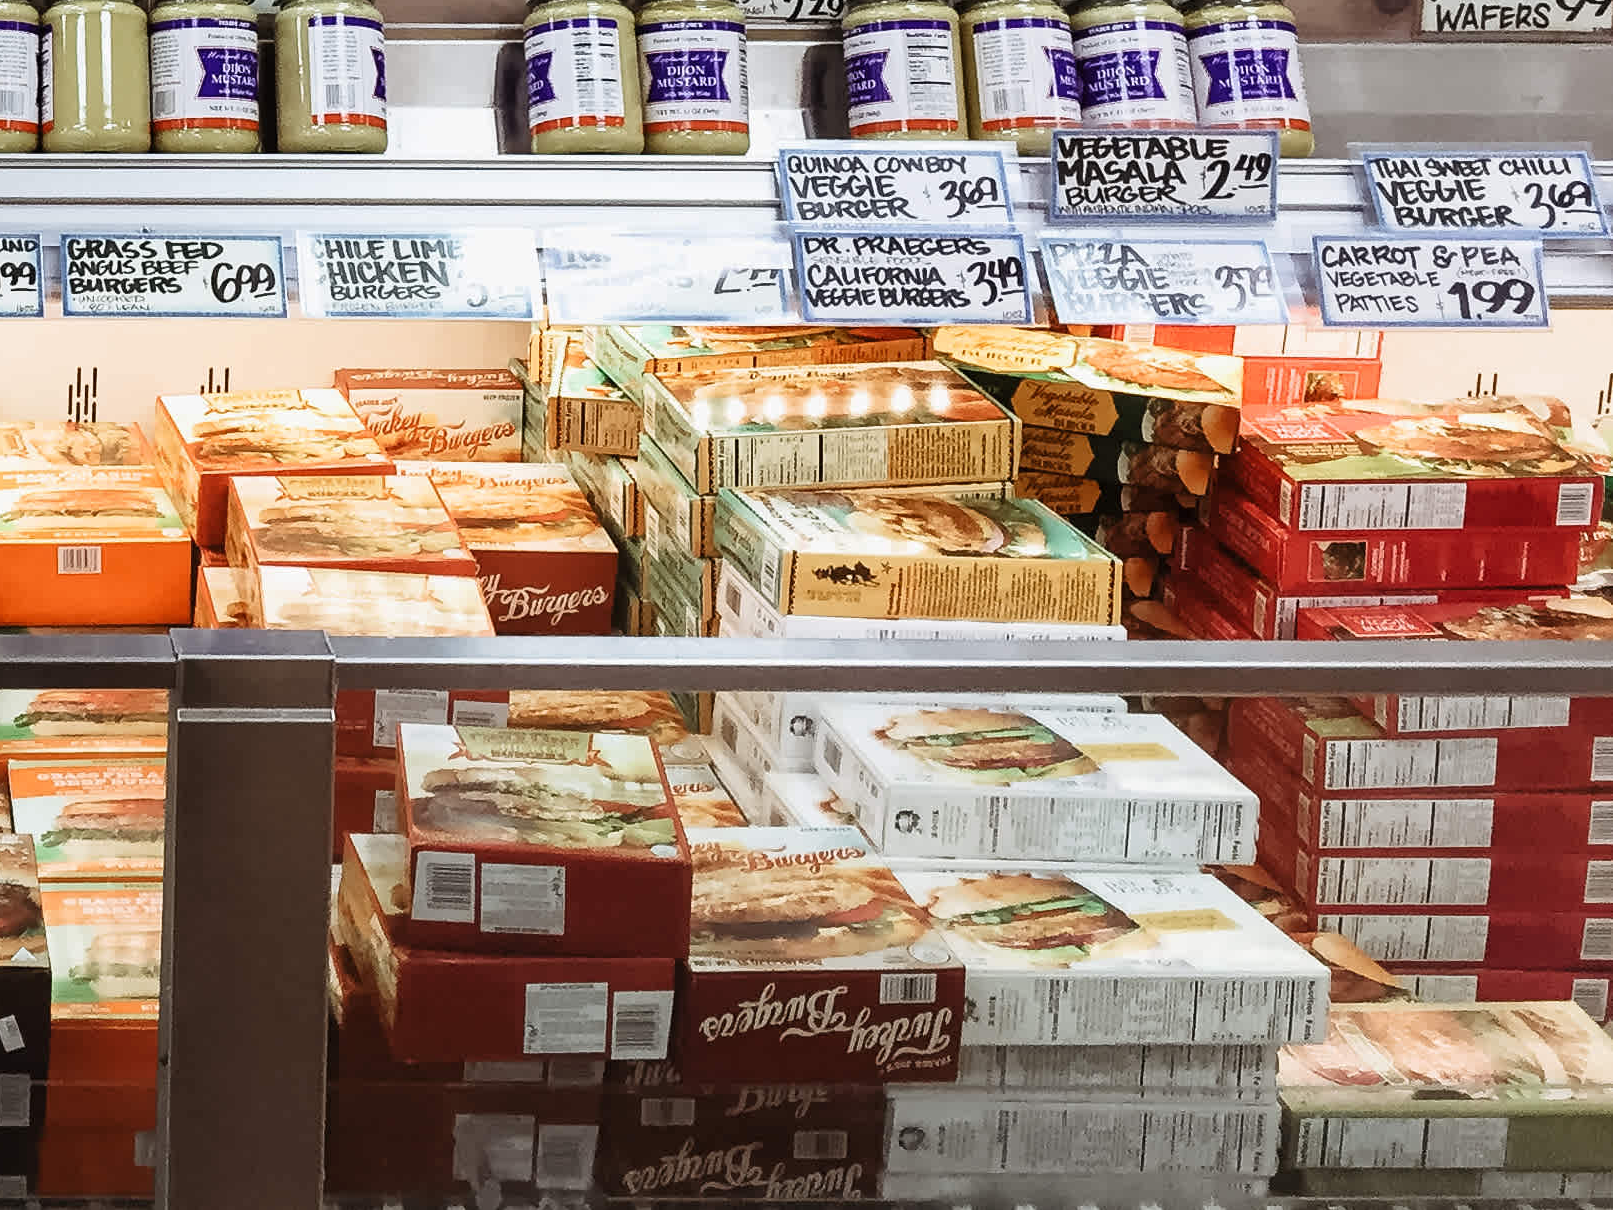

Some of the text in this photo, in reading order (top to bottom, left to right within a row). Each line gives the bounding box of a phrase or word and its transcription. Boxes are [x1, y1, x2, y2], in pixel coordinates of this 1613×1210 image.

[1436, 4, 1551, 32] WAFERS
[666, 64, 706, 76] DIJON
[658, 77, 717, 88] MUSTARD
[1058, 137, 1230, 161] VEGETABLE
[787, 156, 967, 174] QUINOA COWBOY
[1058, 160, 1187, 186] MASALA
[1375, 158, 1423, 179] THAI
[1425, 159, 1491, 177] SWEET
[790, 176, 897, 199] VEGGIE
[1066, 185, 1186, 207] BURGER
[1376, 179, 1486, 206] VEGGIE
[797, 198, 918, 221] BURGER
[1394, 206, 1523, 228] BURGER
[68, 240, 224, 260] GRASS FED
[853, 238, 991, 256] PRAEGERS
[1321, 245, 1422, 269] CARROT
[1462, 246, 1521, 267] PEA
[68, 260, 200, 276] ANGUS BEEF
[807, 265, 946, 287] CALIFORNIA
[69, 277, 183, 294] BURGERS
[1326, 271, 1441, 288] VEGETABLE
[330, 285, 441, 301] BURGERS
[806, 288, 971, 308] VEGGIE BURGERS
[1337, 293, 1419, 314] PATTIES
[499, 583, 610, 623] Burgers
[699, 983, 848, 1043] Burgers
[848, 1005, 954, 1065] Turkey
